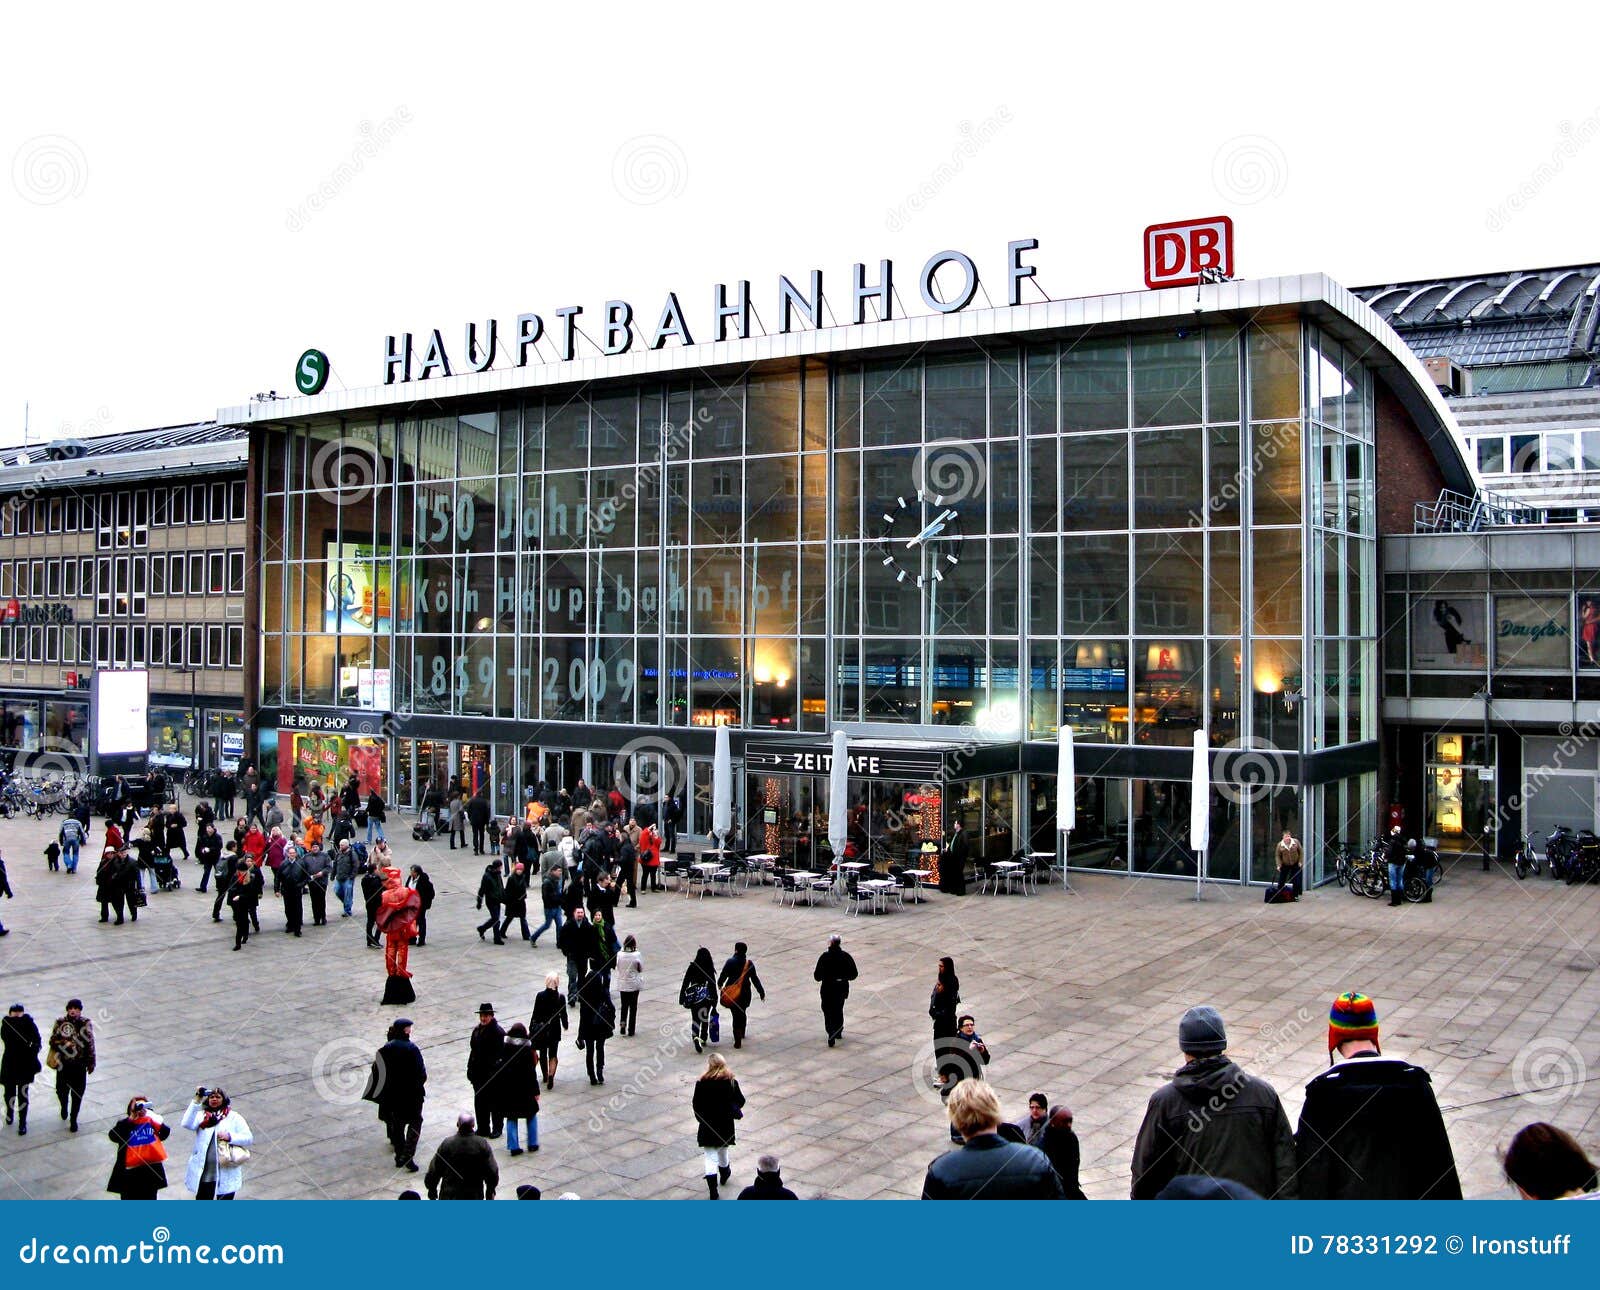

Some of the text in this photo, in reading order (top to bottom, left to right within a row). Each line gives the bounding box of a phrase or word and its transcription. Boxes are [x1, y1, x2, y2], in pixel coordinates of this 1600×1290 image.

[1155, 228, 1220, 277] DB
[384, 238, 1038, 385] HAUPTBAHNHOF
[301, 354, 319, 389] S
[417, 486, 617, 543] 150 Jahre
[416, 570, 792, 620] Köln Hauptbahnhof
[415, 655, 494, 697] 1859
[544, 657, 634, 702] 2009
[223, 733, 243, 748] Chang
[280, 714, 348, 729] THE BODY SHOP
[325, 750, 338, 762] SALE
[794, 753, 880, 774] ZEITAFE
